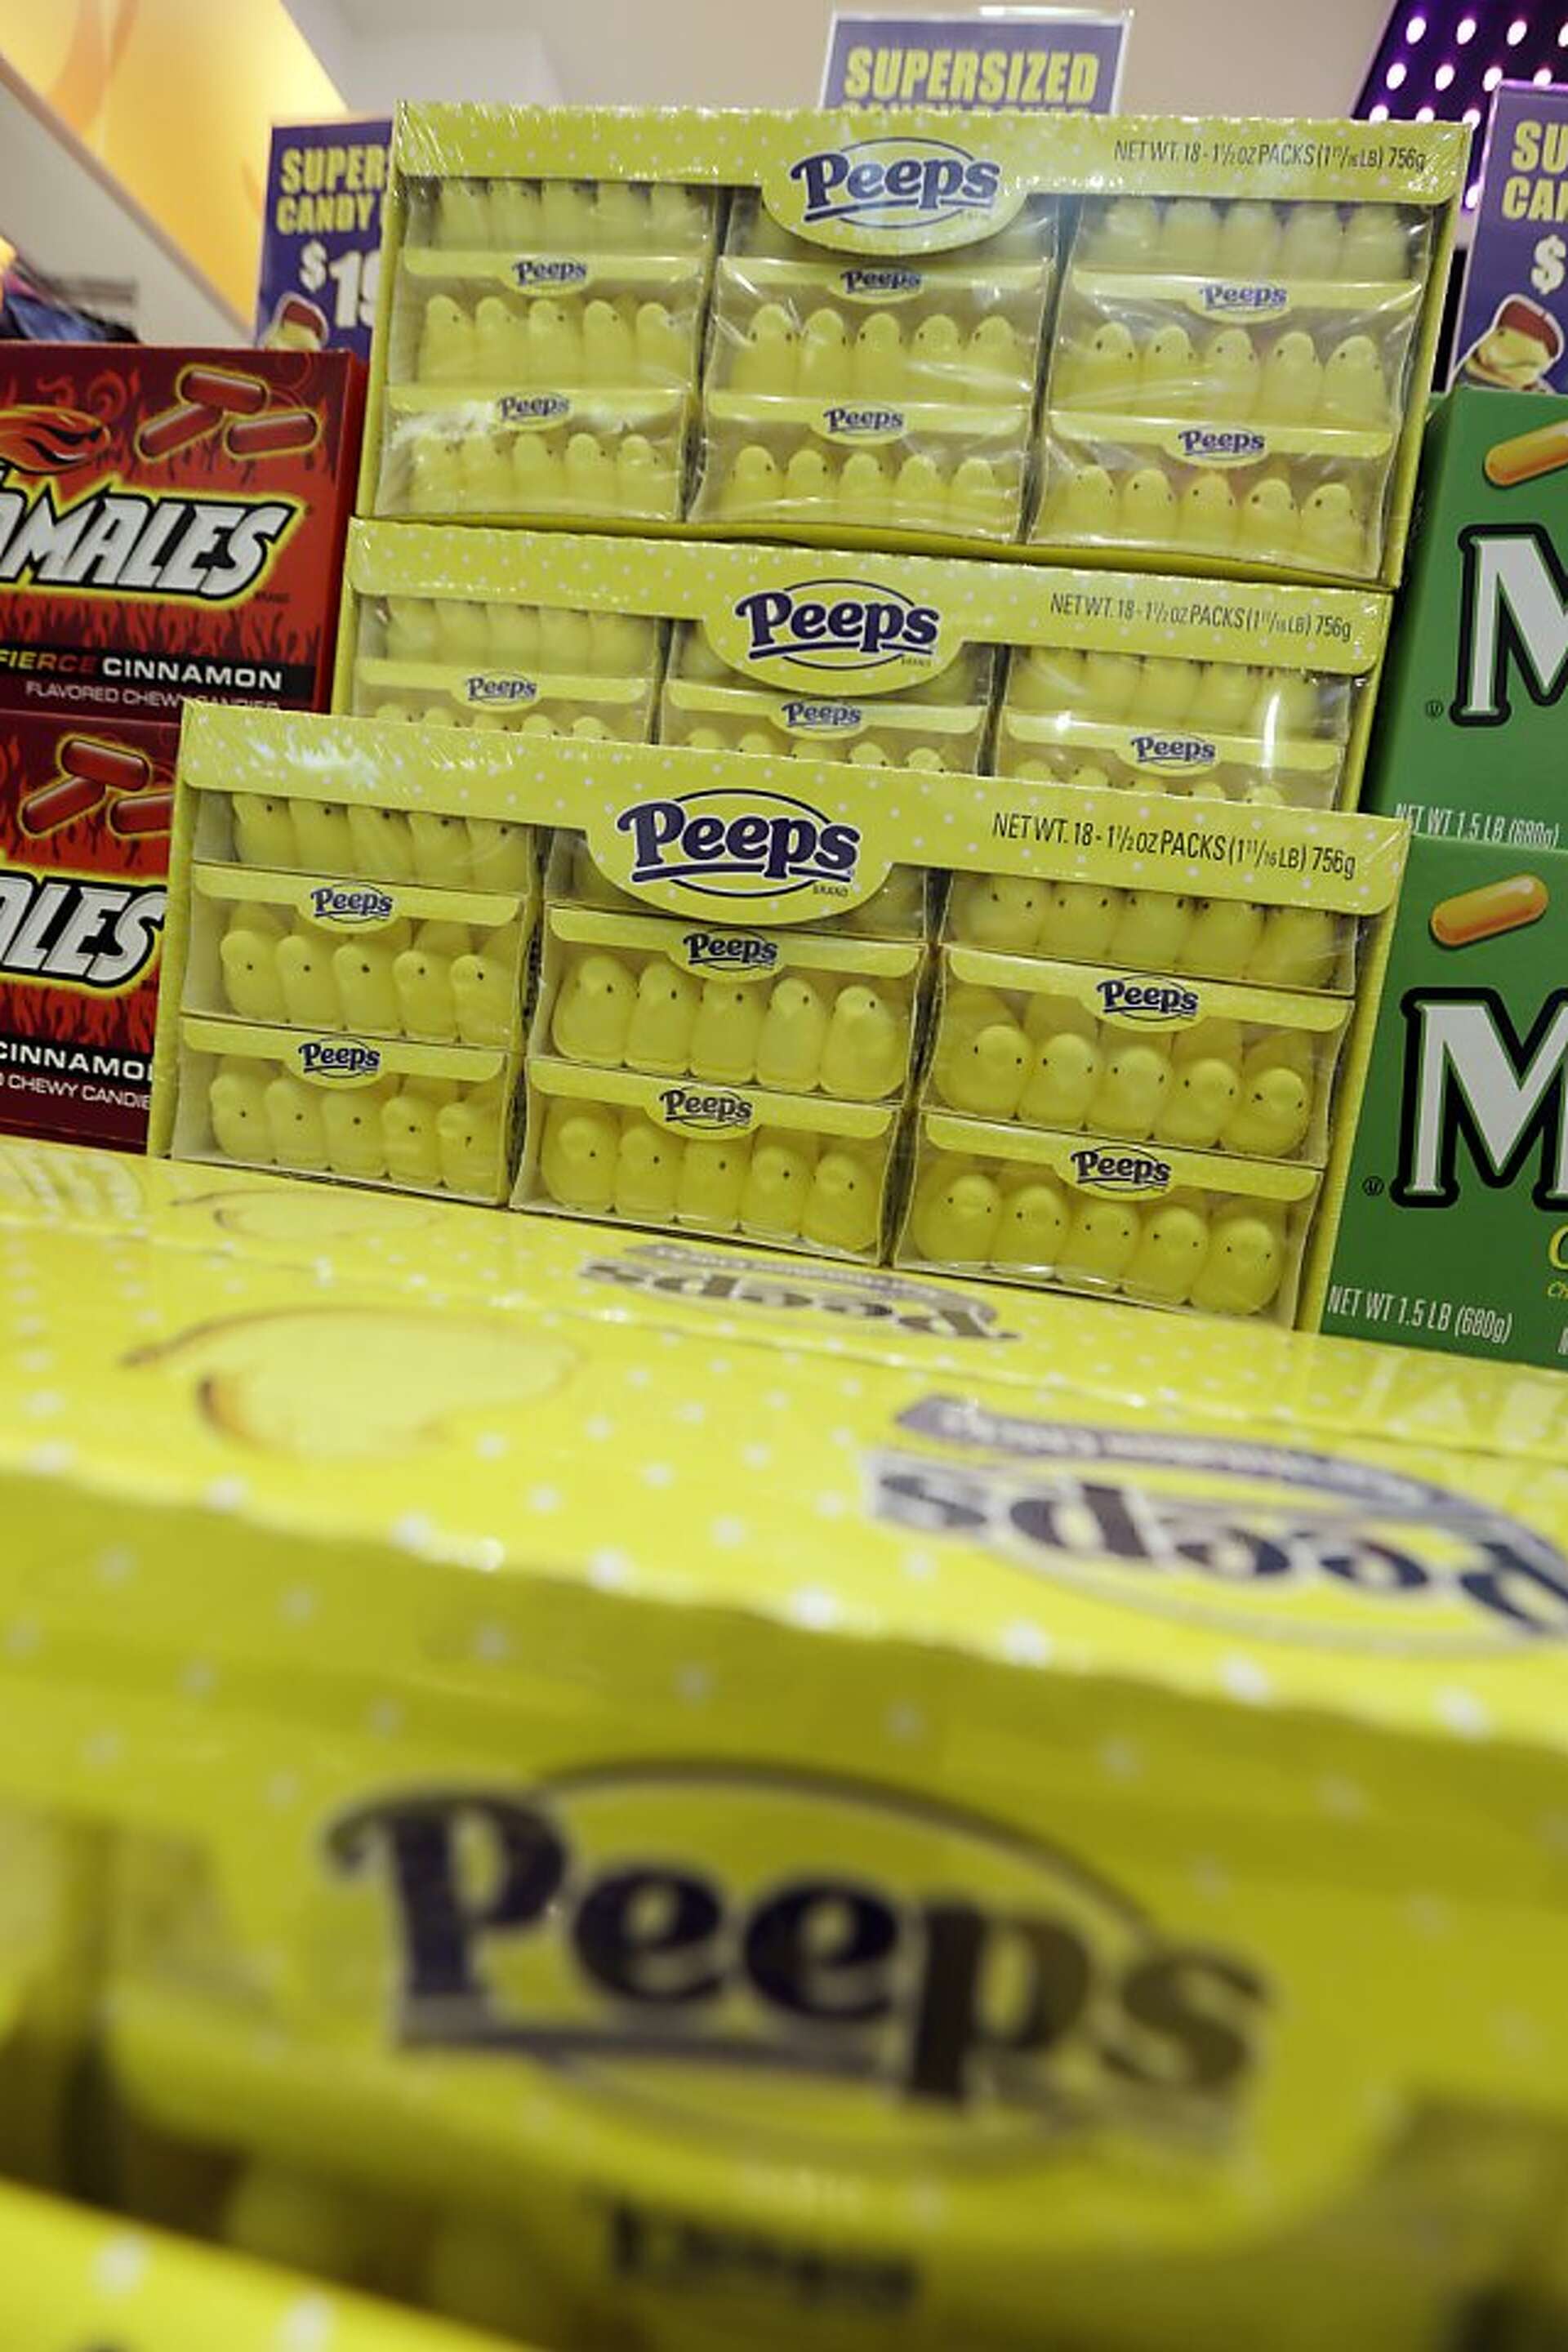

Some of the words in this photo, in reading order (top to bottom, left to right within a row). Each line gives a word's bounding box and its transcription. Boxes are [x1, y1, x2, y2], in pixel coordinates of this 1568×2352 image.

[844, 48, 1099, 104] SUPERSIZED
[1114, 139, 1149, 162] NET
[1183, 142, 1201, 163] 18
[1258, 143, 1316, 166] PACKS
[1388, 146, 1427, 173] 756g
[791, 151, 1001, 211] Peeps
[276, 193, 376, 235] CANDY
[511, 258, 586, 285] Peeps
[840, 268, 921, 292] Peeps
[1199, 282, 1287, 307] Peeps
[497, 394, 570, 418] Peeps
[823, 408, 904, 433] Peeps
[1178, 430, 1265, 455] Peeps
[736, 591, 940, 653] Peeps
[1050, 592, 1082, 617] NET
[1118, 599, 1135, 621] 18
[1190, 604, 1245, 629] PACKS
[1315, 615, 1352, 643] 756g
[102, 657, 283, 691] CINNAMON
[466, 676, 537, 700] Peeps
[26, 680, 119, 703] FLAVORED
[781, 701, 862, 727] Peeps
[1131, 735, 1216, 763] Peeps
[617, 801, 862, 880] Peeps
[992, 812, 1031, 839] NET
[1034, 817, 1069, 844] WT.
[1074, 822, 1094, 847] 18
[1160, 829, 1226, 862] PACKS
[1278, 843, 1307, 872] LB)
[1312, 846, 1356, 881] 756g
[311, 886, 393, 920] Peeps
[683, 932, 777, 968] Peeps
[1097, 979, 1200, 1013] Peeps
[0, 1040, 153, 1082] INNAMO
[299, 1040, 381, 1073] Peeps
[8, 1074, 78, 1098] CHEWY
[659, 1088, 753, 1124] Peeps
[1070, 1150, 1171, 1183] Peeps
[1327, 1285, 1361, 1318] NET
[1365, 1290, 1396, 1322] WT
[1397, 1296, 1427, 1328] 1.5
[1428, 1300, 1452, 1332] LB
[1454, 1304, 1513, 1345] (680g)
[323, 1786, 1272, 2115] Peeps
